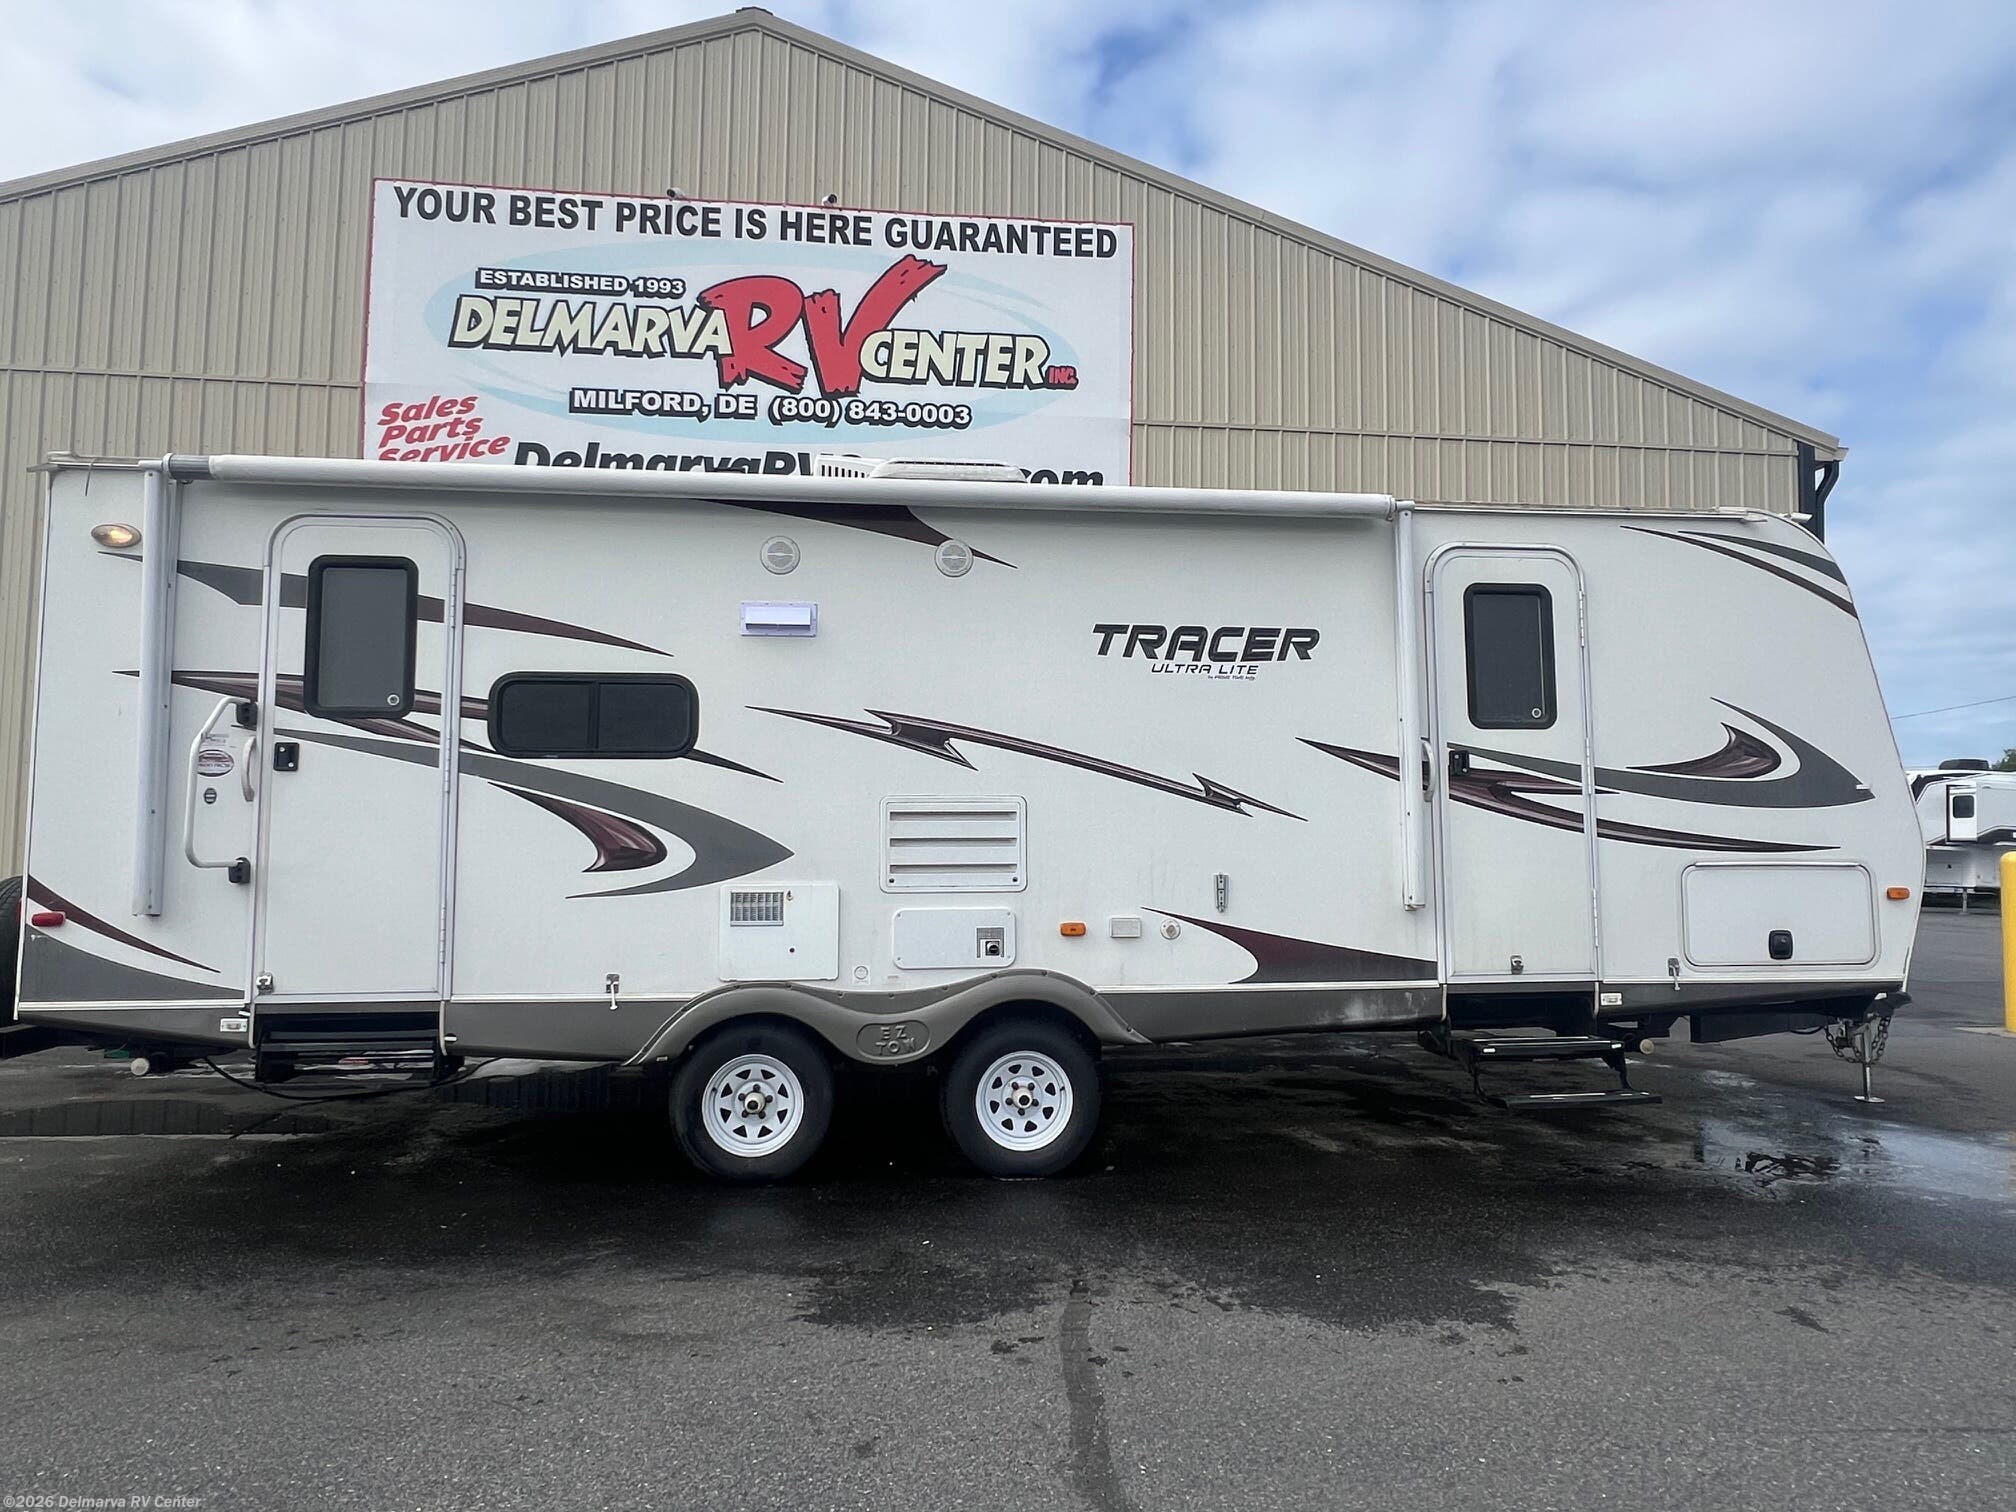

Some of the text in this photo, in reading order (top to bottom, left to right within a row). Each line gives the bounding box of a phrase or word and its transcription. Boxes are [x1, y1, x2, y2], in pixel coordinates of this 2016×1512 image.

[394, 186, 1118, 259] YOUR BEST PRICE IS HERE GUARANTEED
[478, 268, 685, 295] ESTABLISHED 1993
[449, 254, 1079, 399] DELMARVA RV CENTER INC.
[377, 395, 479, 426] Sales
[572, 388, 971, 427] MILFORD, DE (800) 843-0003
[378, 417, 484, 449] Parts
[1092, 623, 1321, 663] TRACER
[1151, 663, 1259, 675] ULTRA LITE
